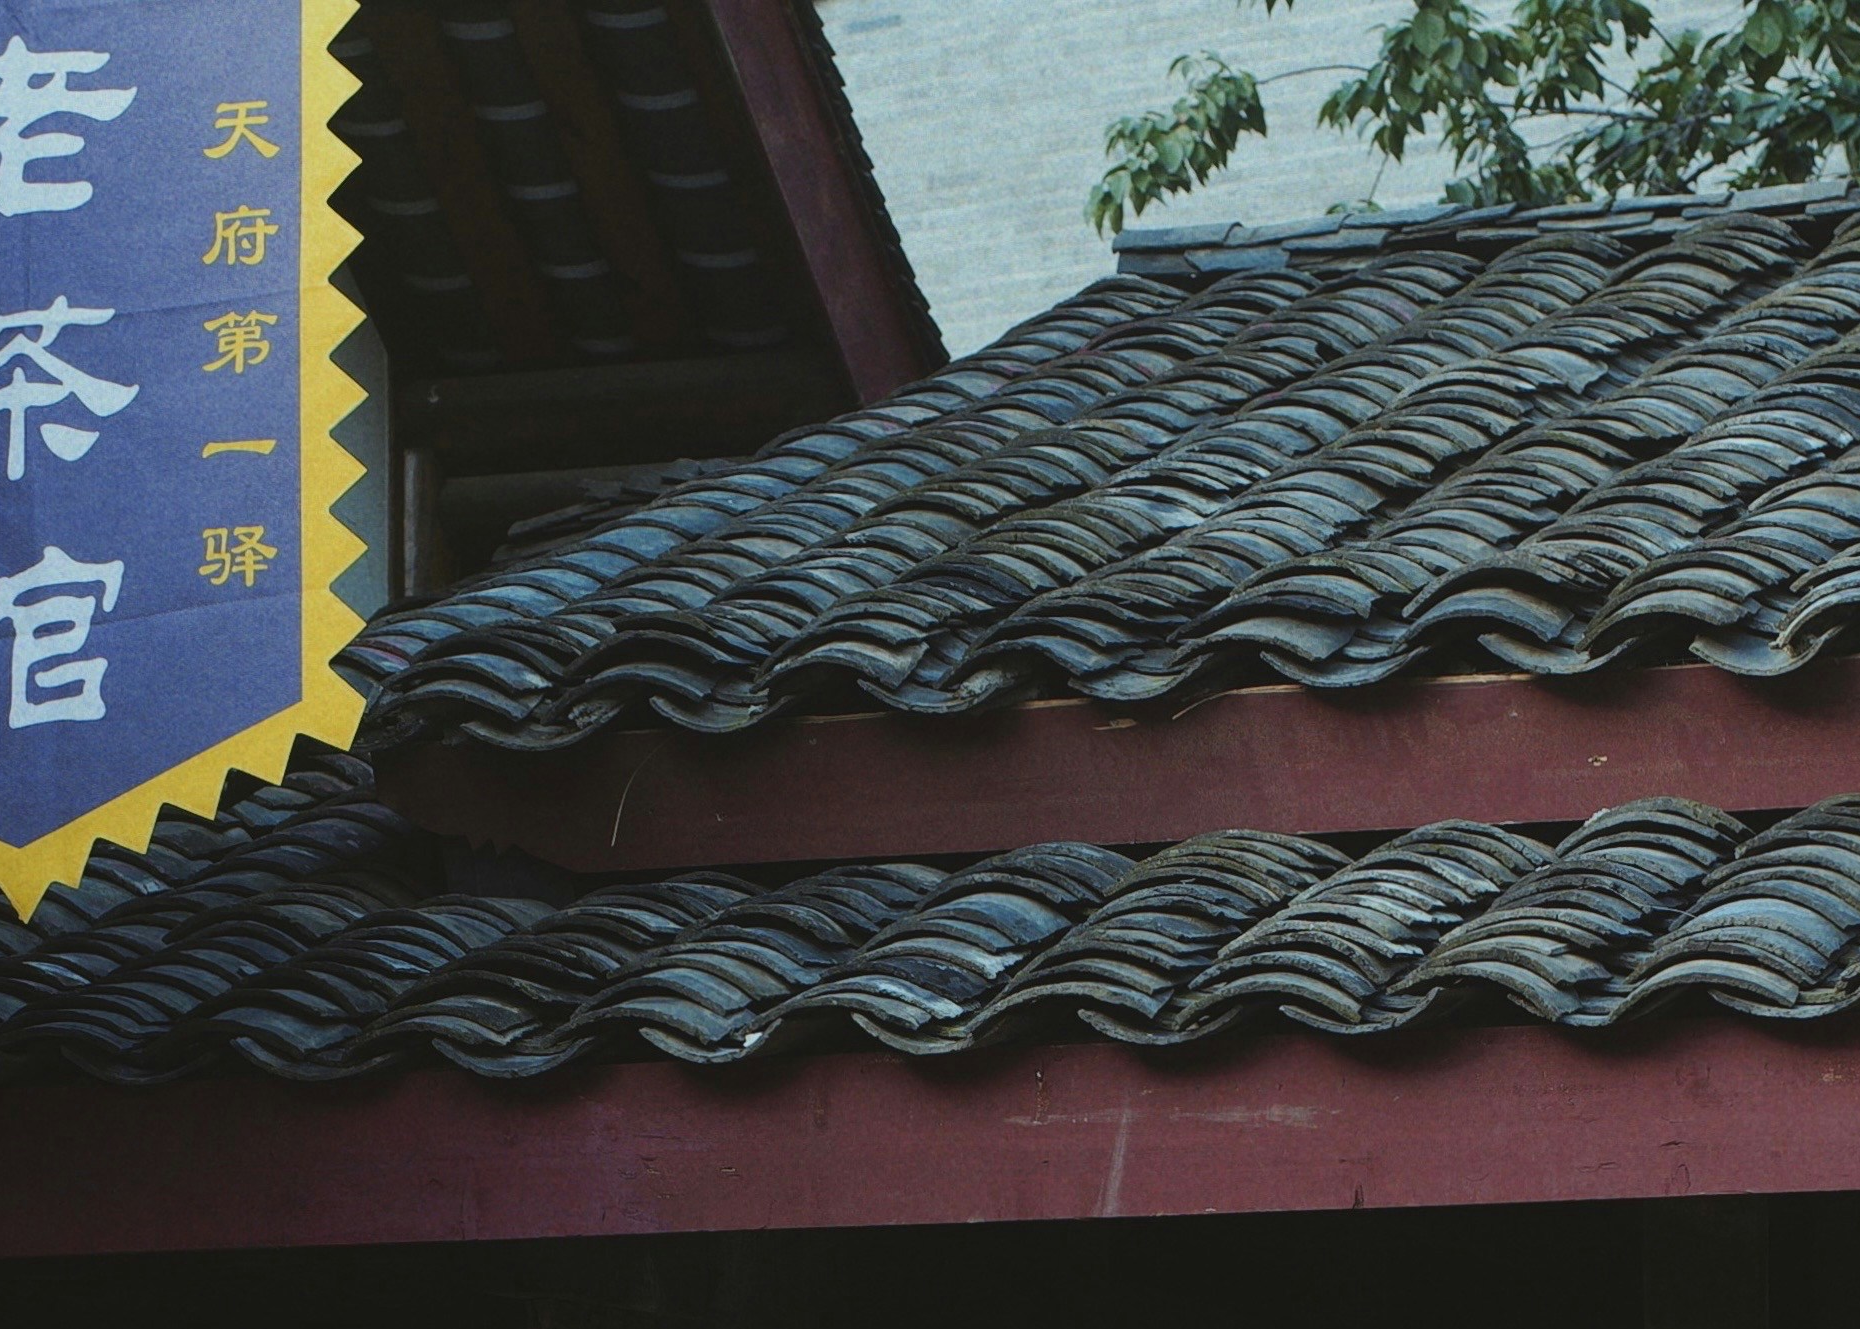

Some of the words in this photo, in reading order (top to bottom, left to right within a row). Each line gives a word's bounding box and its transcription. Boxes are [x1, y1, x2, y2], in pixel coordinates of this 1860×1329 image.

[198, 100, 280, 588] 天府第一驿
